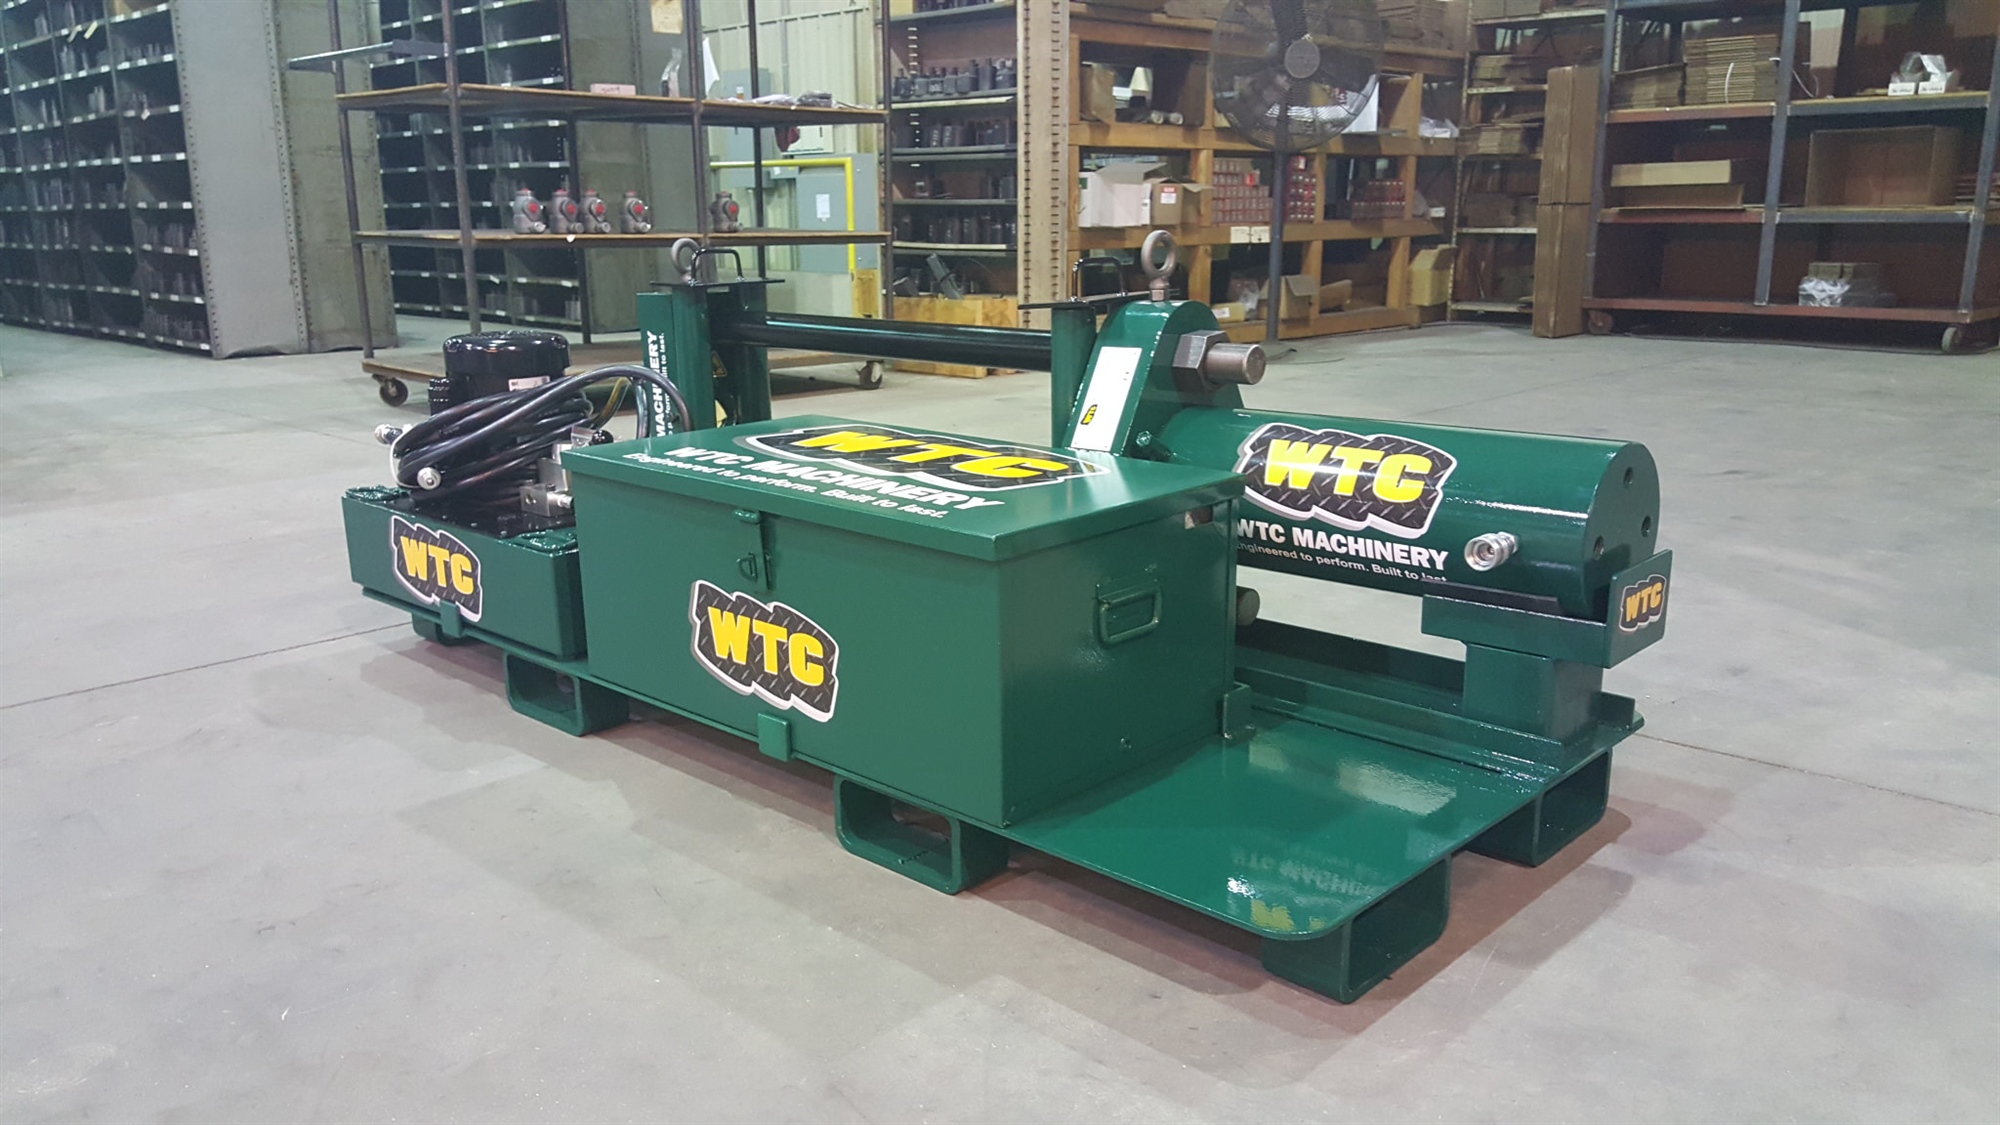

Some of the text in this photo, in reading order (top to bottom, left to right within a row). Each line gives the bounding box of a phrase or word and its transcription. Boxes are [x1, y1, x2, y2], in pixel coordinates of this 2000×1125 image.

[661, 354, 667, 365] to
[663, 446, 1006, 510] WTC MACHINERY
[790, 431, 1069, 479] WTC
[1264, 438, 1433, 504] WTC
[622, 452, 949, 519] Engineered to perform. Built to last.
[400, 535, 475, 596] WTC
[1236, 518, 1449, 571] WTC MACHINERY
[1299, 552, 1313, 561] to
[1315, 556, 1369, 572] perform.
[1371, 563, 1403, 577] Built
[1404, 569, 1419, 580] to
[1626, 582, 1662, 622] WTC
[707, 606, 825, 687] WTC
